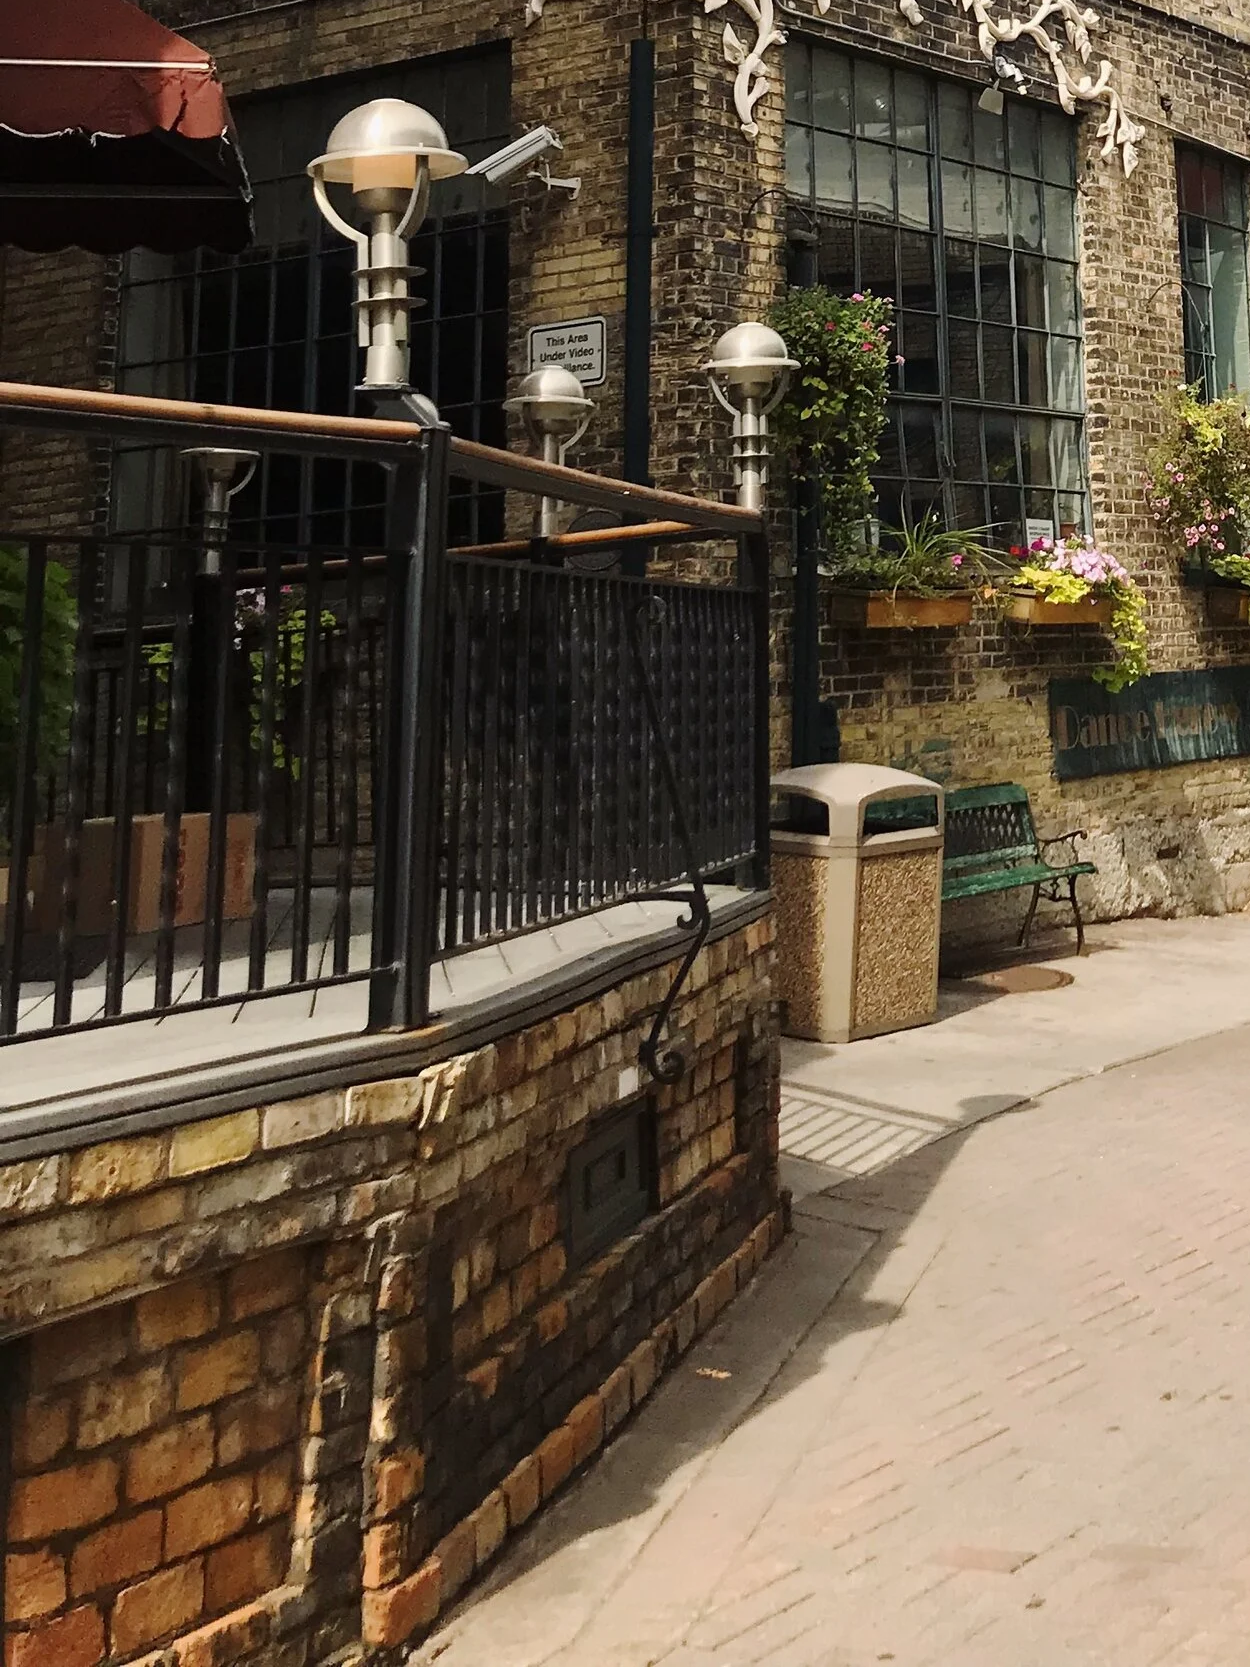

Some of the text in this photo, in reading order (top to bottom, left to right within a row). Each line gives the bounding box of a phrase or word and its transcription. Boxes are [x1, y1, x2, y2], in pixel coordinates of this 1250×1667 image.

[546, 334, 589, 347] This Area
[539, 347, 595, 363] Under Video
[1054, 704, 1151, 751] Dance
